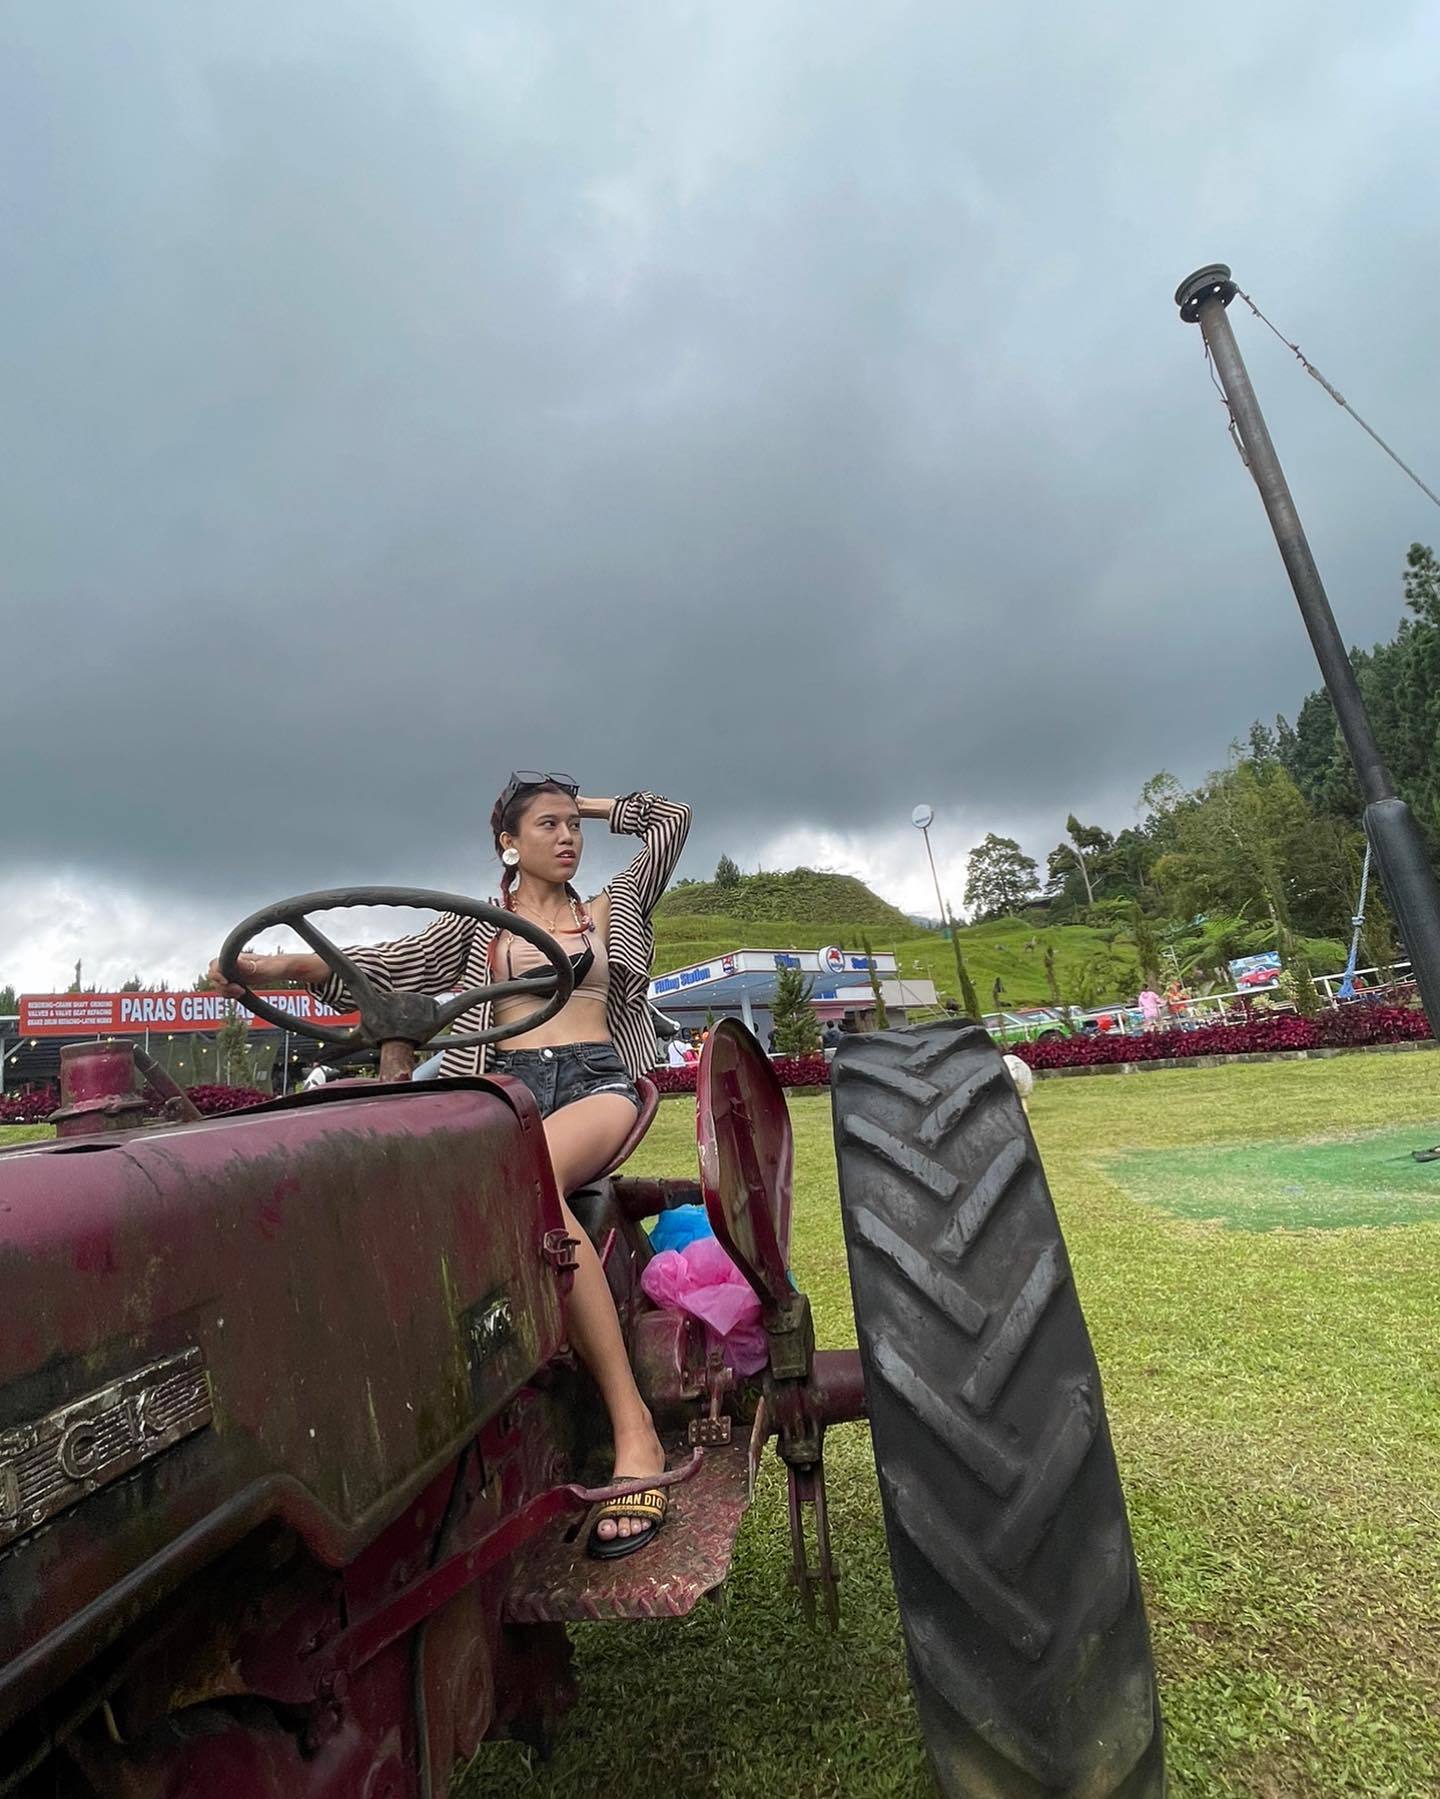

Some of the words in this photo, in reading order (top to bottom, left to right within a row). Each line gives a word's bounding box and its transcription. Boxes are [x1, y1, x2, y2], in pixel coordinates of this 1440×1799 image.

[680, 967, 711, 987] Station
[120, 997, 176, 1022] PARAS
[260, 995, 312, 1017] EPAIR
